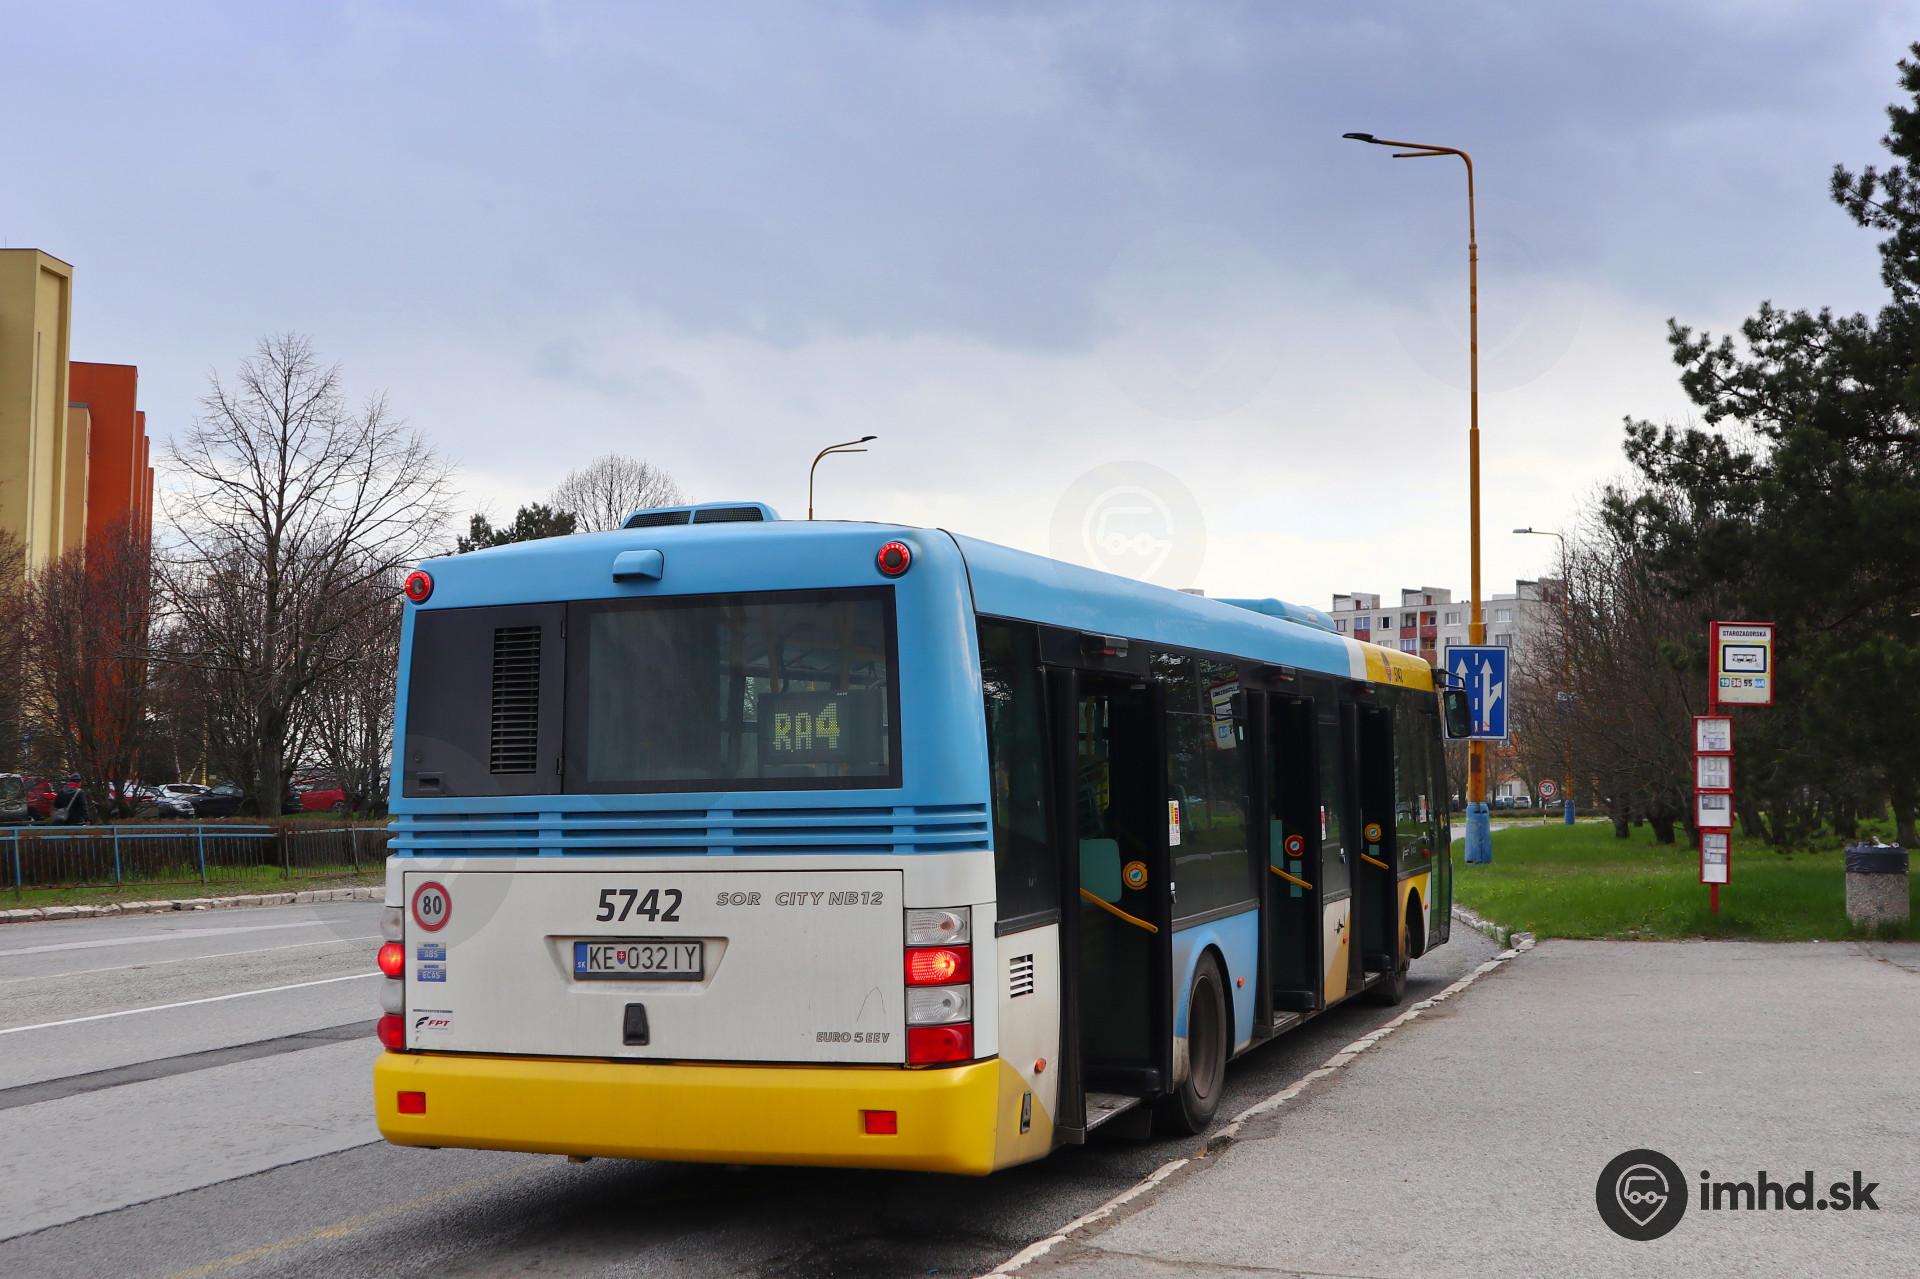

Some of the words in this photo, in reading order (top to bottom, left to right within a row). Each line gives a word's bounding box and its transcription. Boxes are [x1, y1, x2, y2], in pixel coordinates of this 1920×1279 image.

[774, 702, 840, 750] RA4
[423, 895, 442, 915] 80
[596, 888, 683, 922] 5742
[716, 892, 761, 906] SOR
[775, 892, 824, 906] CITY
[828, 891, 884, 905] NB12
[577, 961, 586, 969] SK
[816, 1032, 852, 1043] EURO
[854, 1032, 864, 1043] 5
[865, 1032, 890, 1044] EEV
